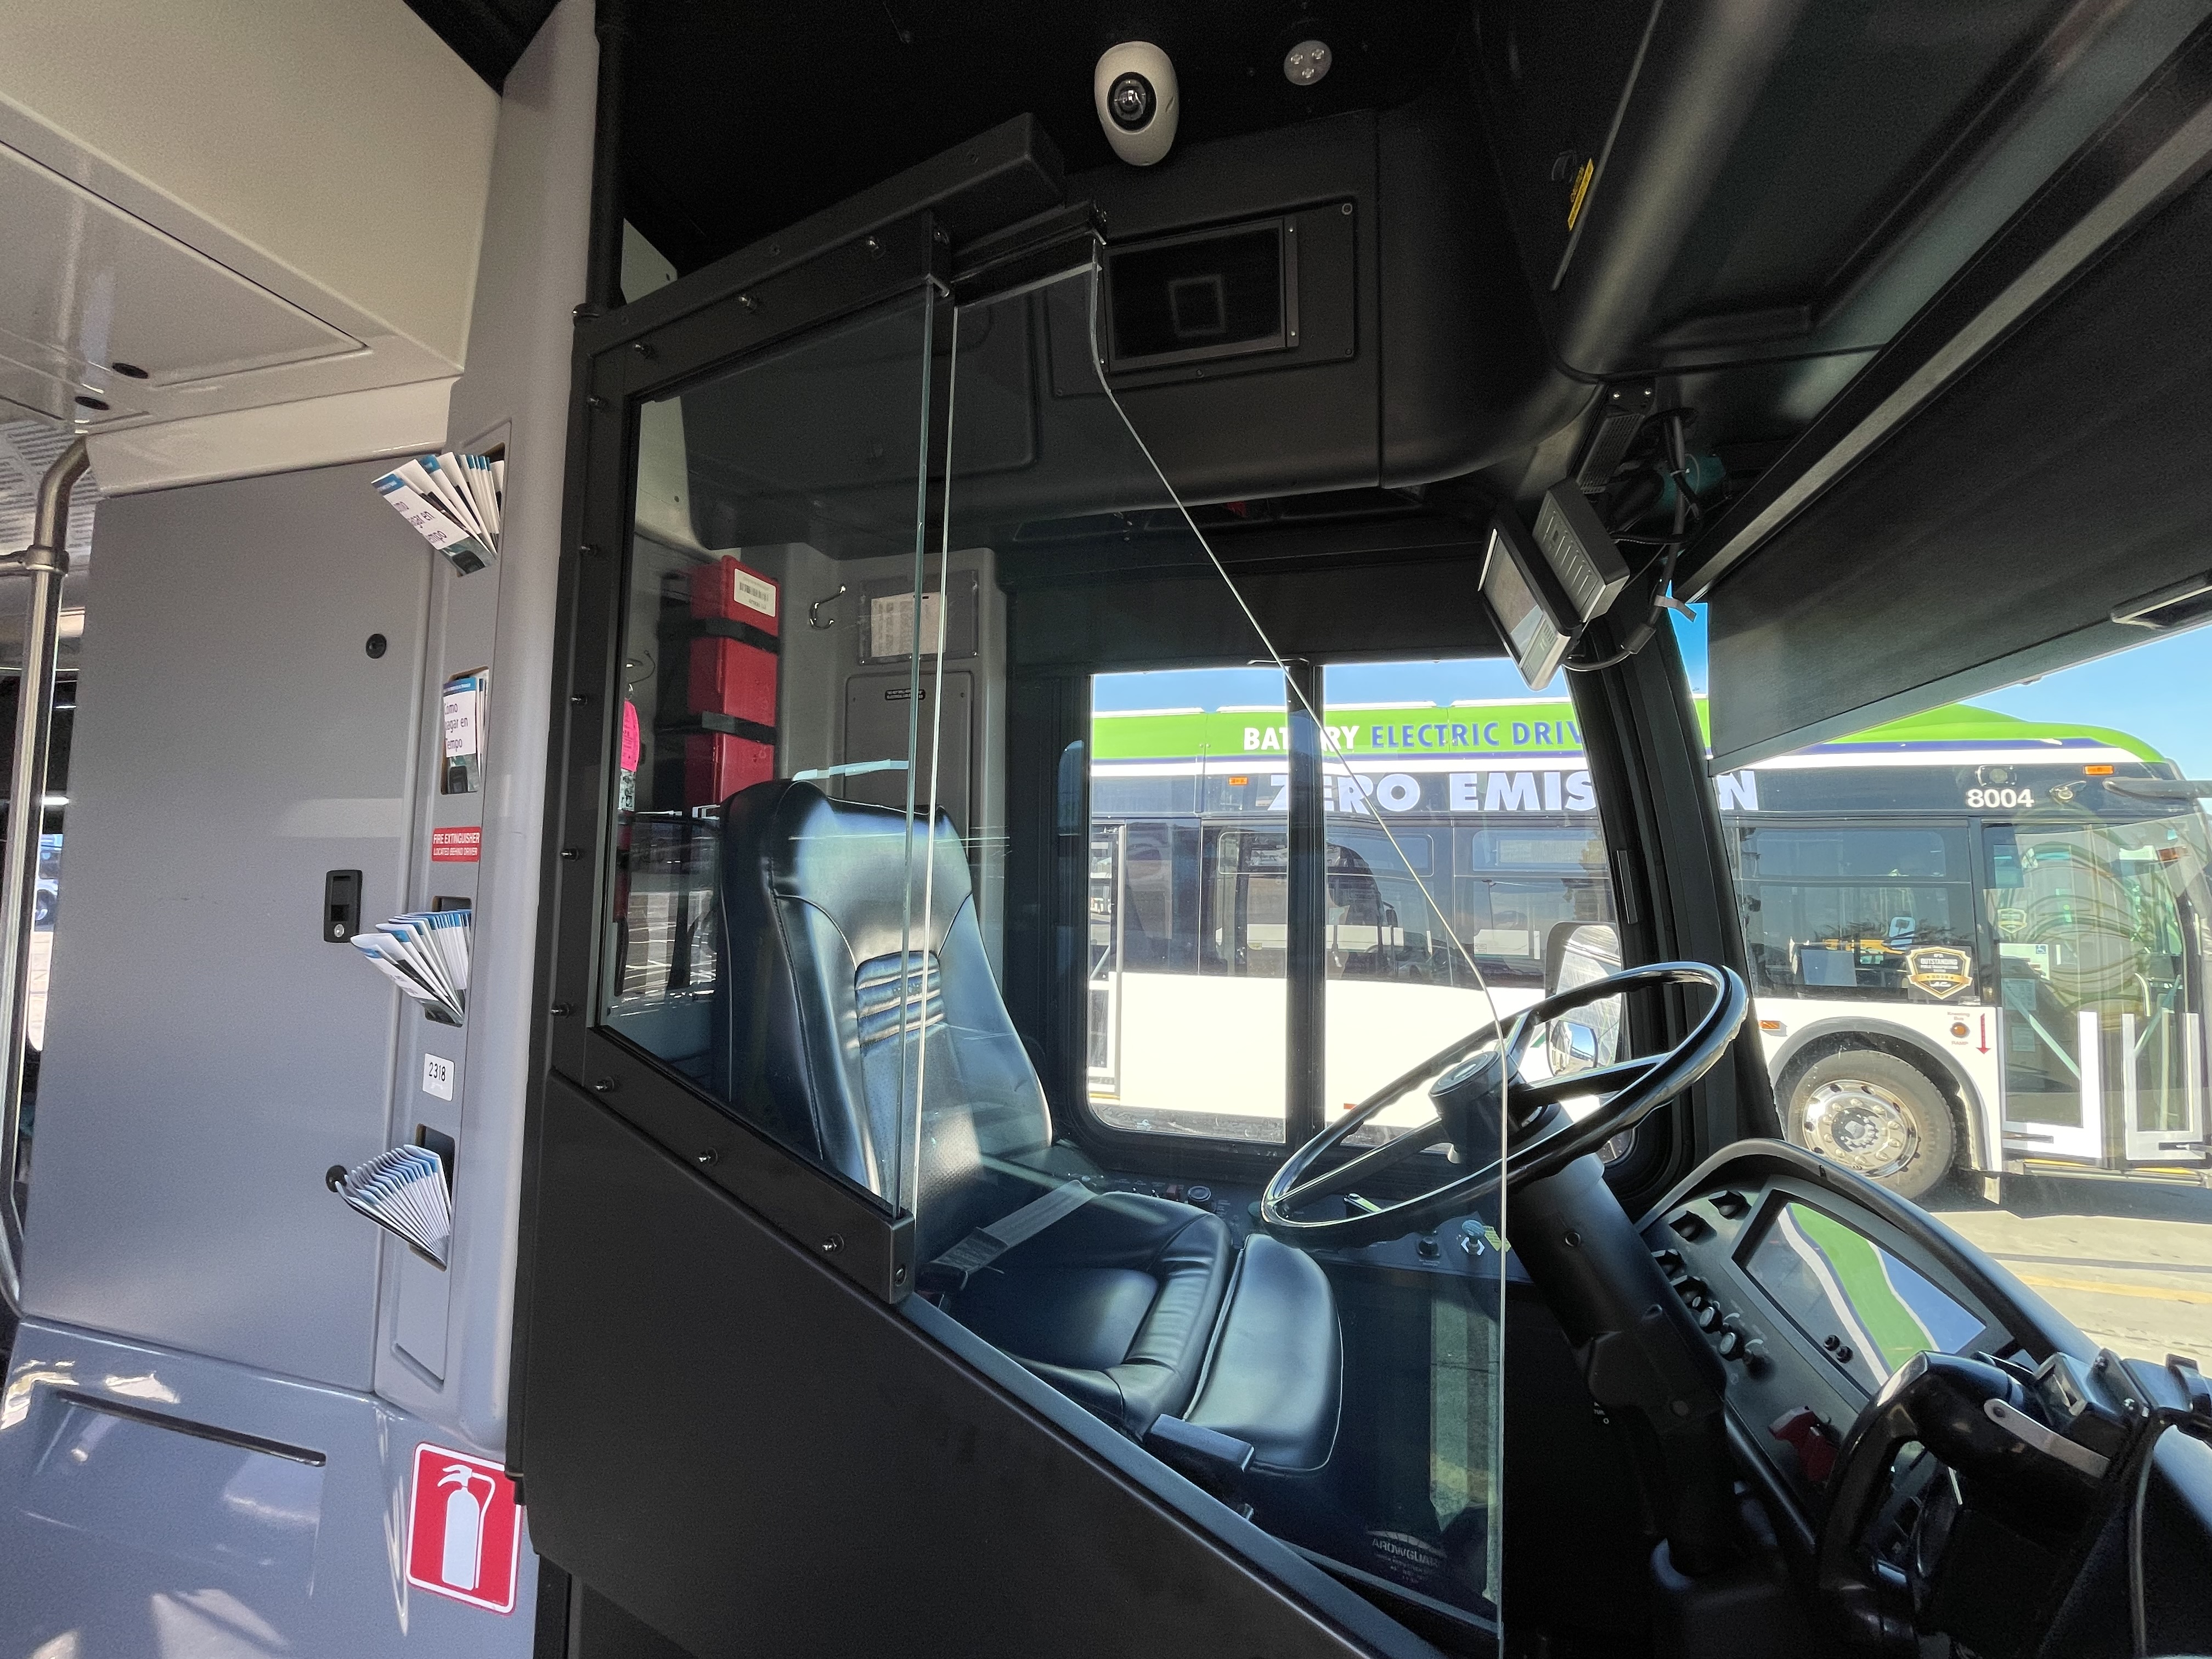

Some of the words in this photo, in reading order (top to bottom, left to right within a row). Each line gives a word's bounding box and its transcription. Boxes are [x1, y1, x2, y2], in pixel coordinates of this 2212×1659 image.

[420, 511, 436, 521] en
[425, 531, 448, 543] empo
[461, 718, 468, 727] en
[1244, 725, 1359, 752] BATRY
[1372, 722, 1500, 748] ELECTRIC
[1511, 721, 1583, 746] DRIV
[1449, 770, 1759, 811] EMISN
[1967, 788, 2035, 808] 8004
[433, 833, 444, 844] FIRE
[444, 832, 480, 844] EXTINGUISHER
[433, 848, 450, 856] LOCATED
[449, 848, 464, 856] BEHIND
[464, 848, 478, 856] DRIVER
[428, 1062, 446, 1082] 2318
